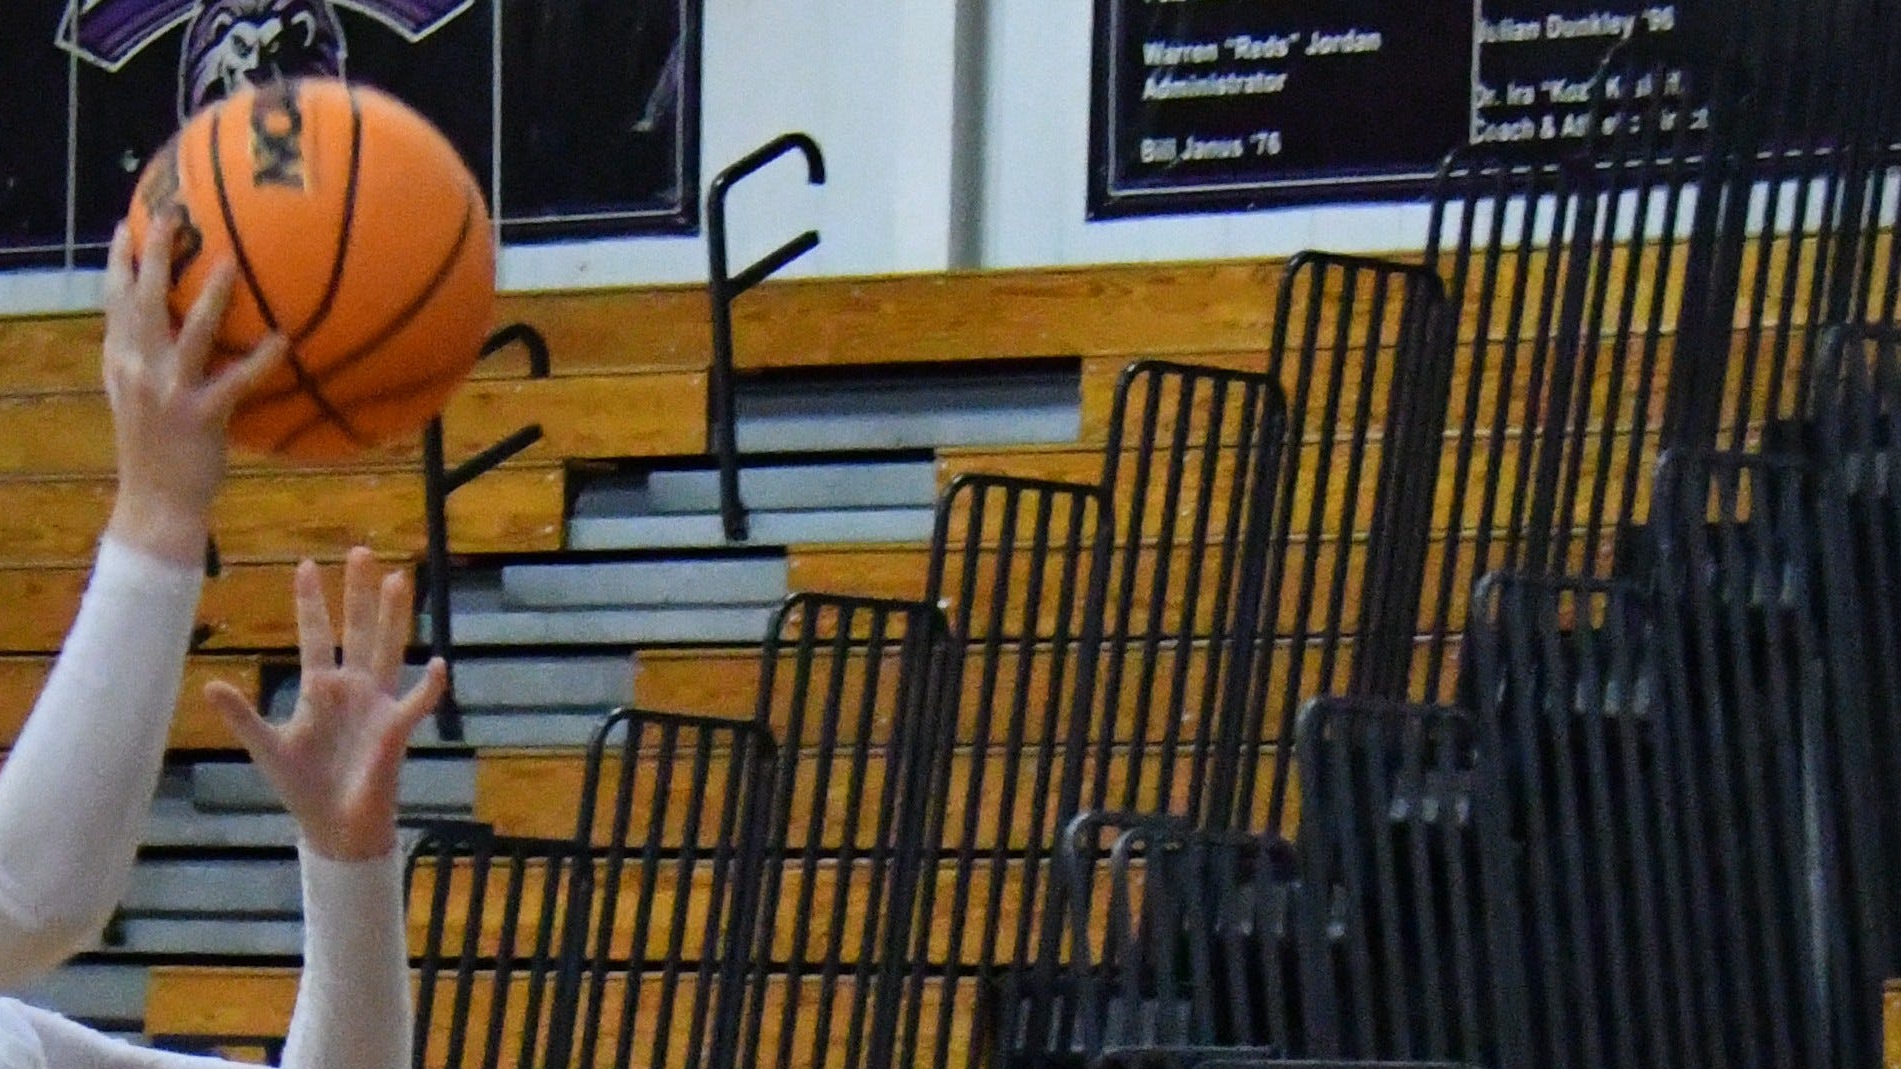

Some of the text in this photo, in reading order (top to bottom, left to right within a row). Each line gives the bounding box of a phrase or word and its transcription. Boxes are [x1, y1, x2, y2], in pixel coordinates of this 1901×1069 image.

[1142, 40, 1218, 66] Warren
[1305, 28, 1382, 56] Jordan
[1142, 70, 1288, 100] Administrator
